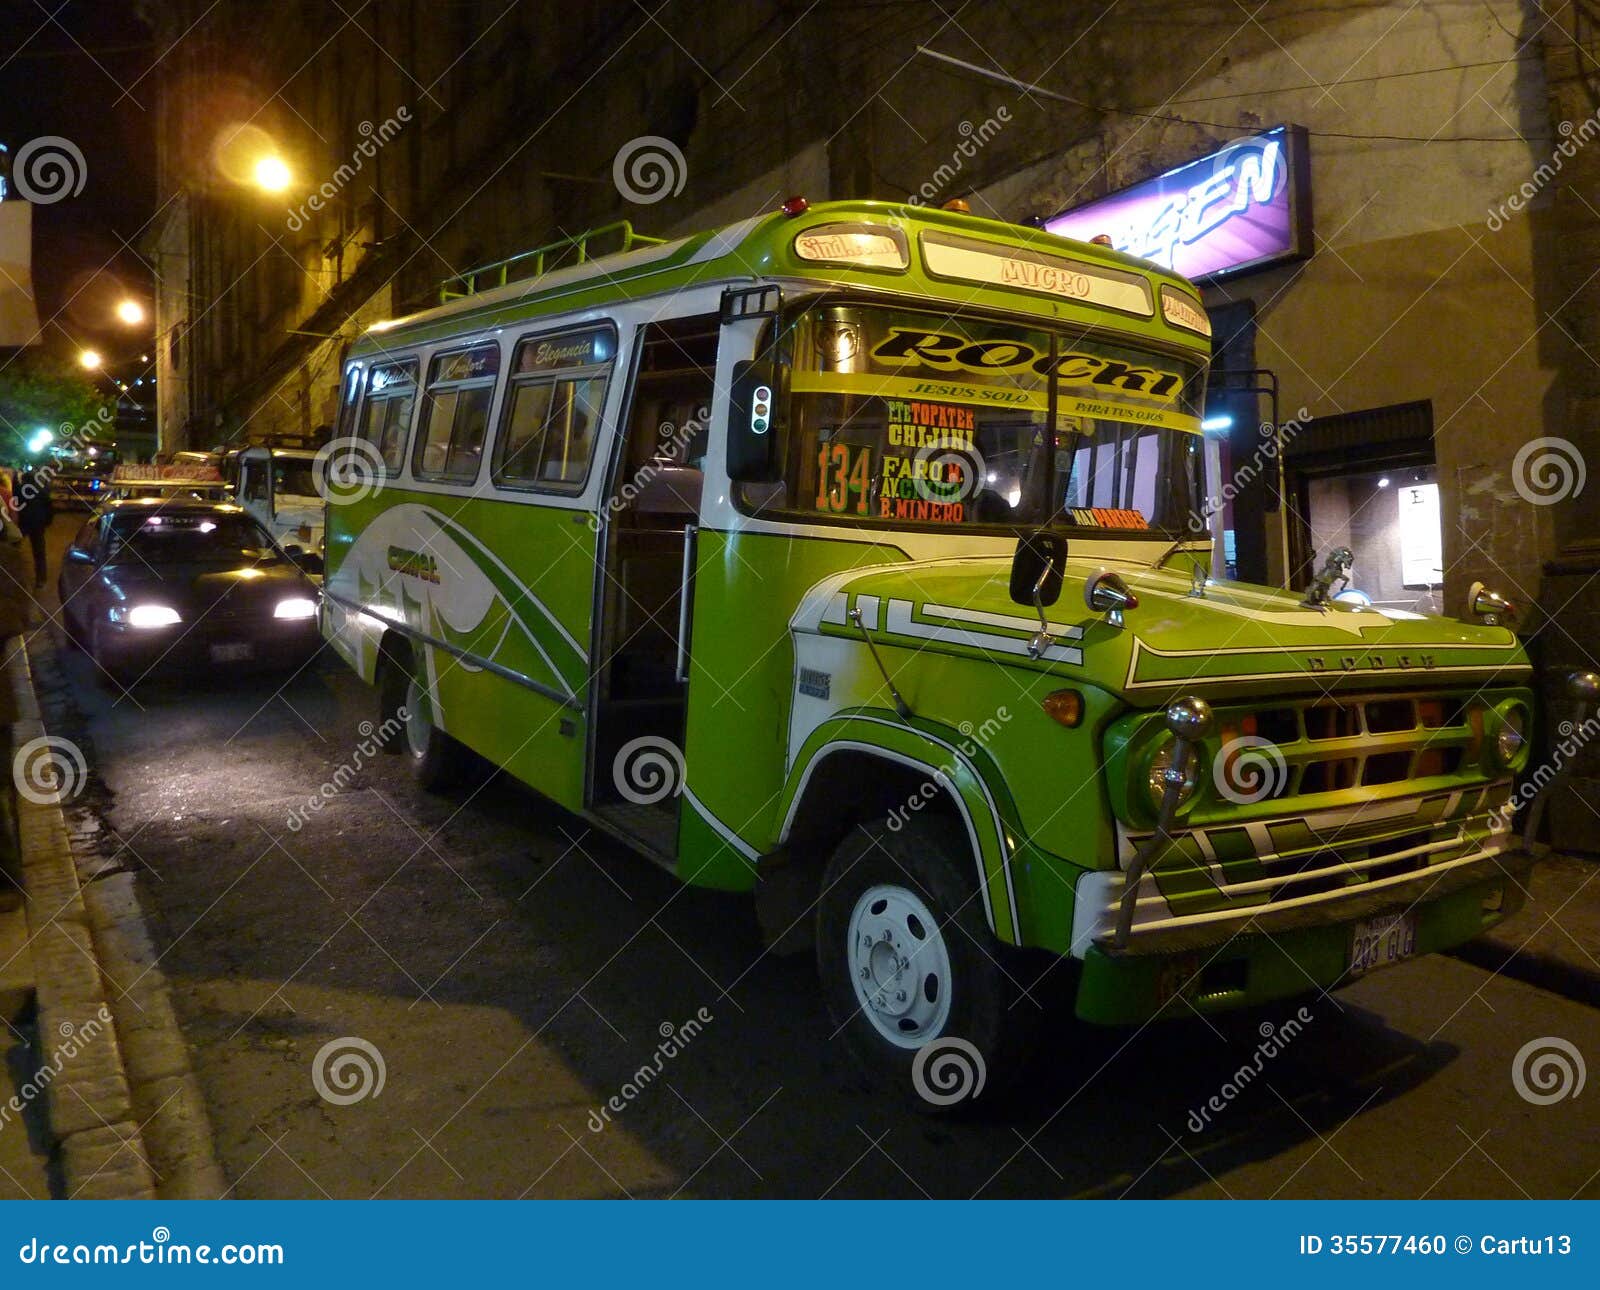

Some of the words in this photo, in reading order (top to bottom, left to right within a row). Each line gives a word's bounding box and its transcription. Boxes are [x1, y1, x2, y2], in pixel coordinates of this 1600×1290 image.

[1001, 260, 1090, 298] MICRO
[873, 329, 1180, 397] ROCKI
[908, 384, 976, 397] JESUS
[980, 390, 1029, 402] SOLO
[817, 443, 870, 516] 134
[882, 456, 943, 482] FARO
